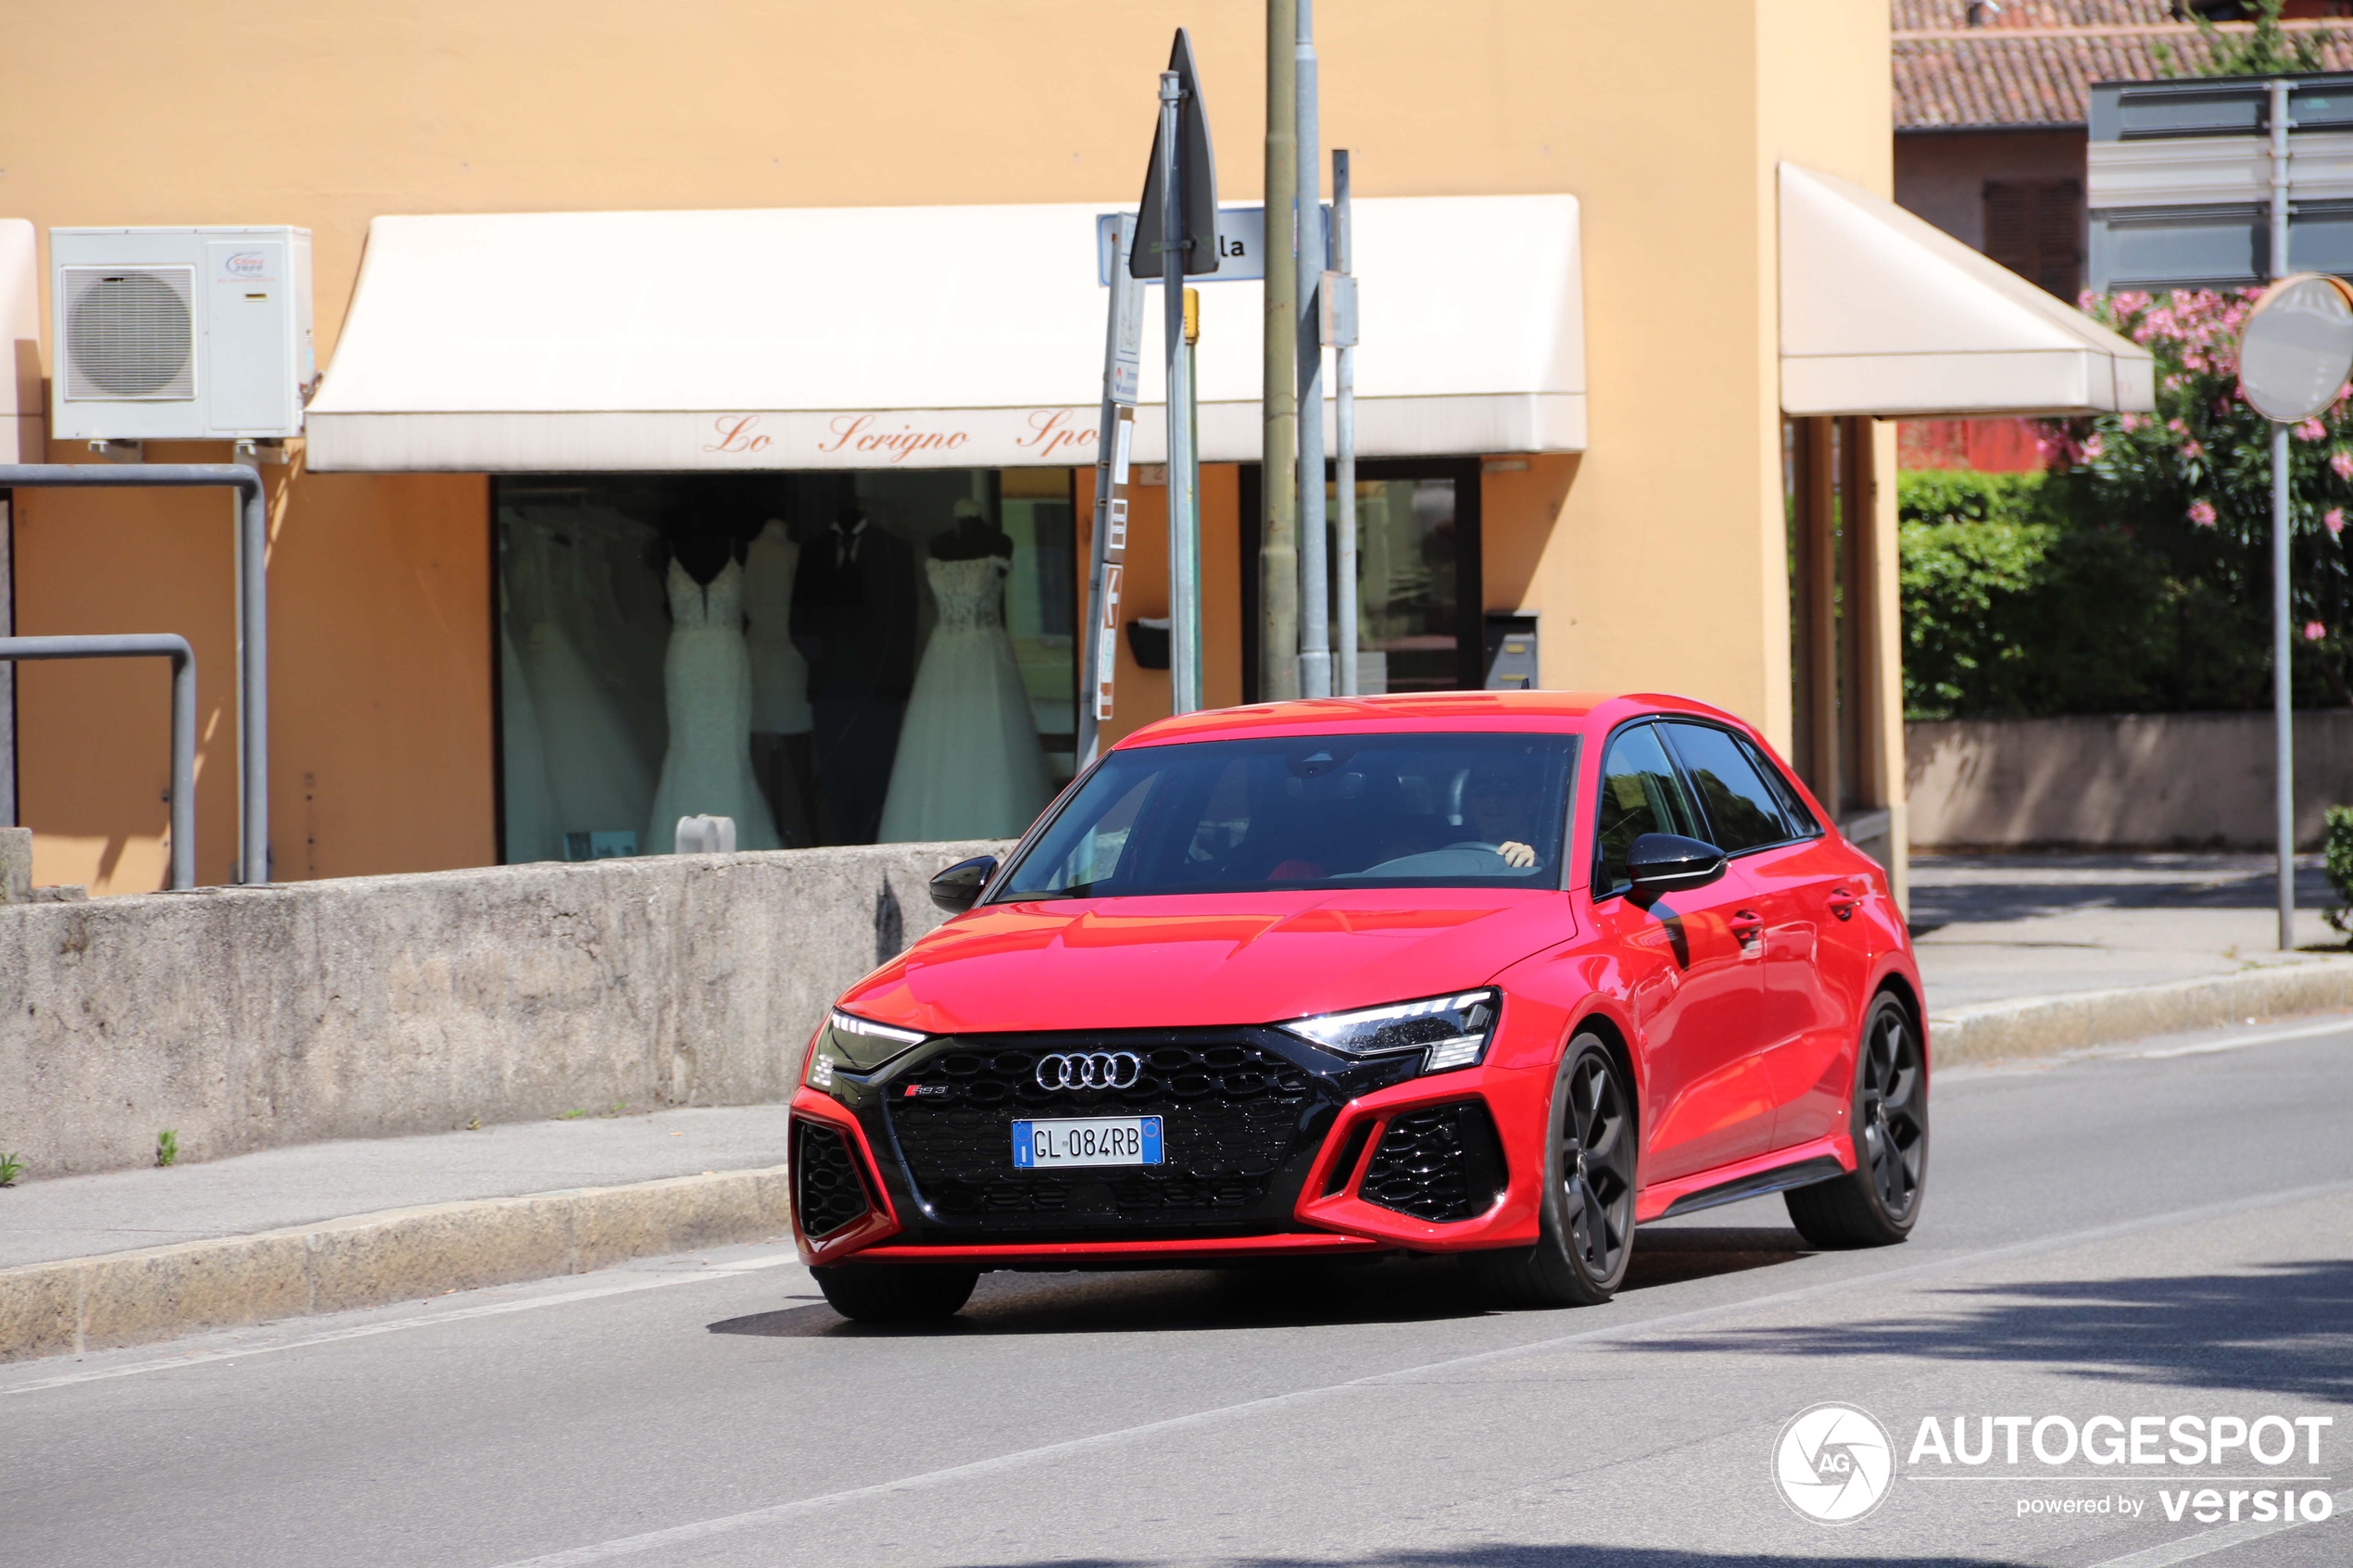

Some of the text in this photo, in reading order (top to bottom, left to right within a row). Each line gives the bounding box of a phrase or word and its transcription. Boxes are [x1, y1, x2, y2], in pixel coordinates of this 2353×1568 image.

[702, 408, 1101, 463] Lo Scrigno Spo
[1035, 1126, 1140, 1159] GL 084RB
